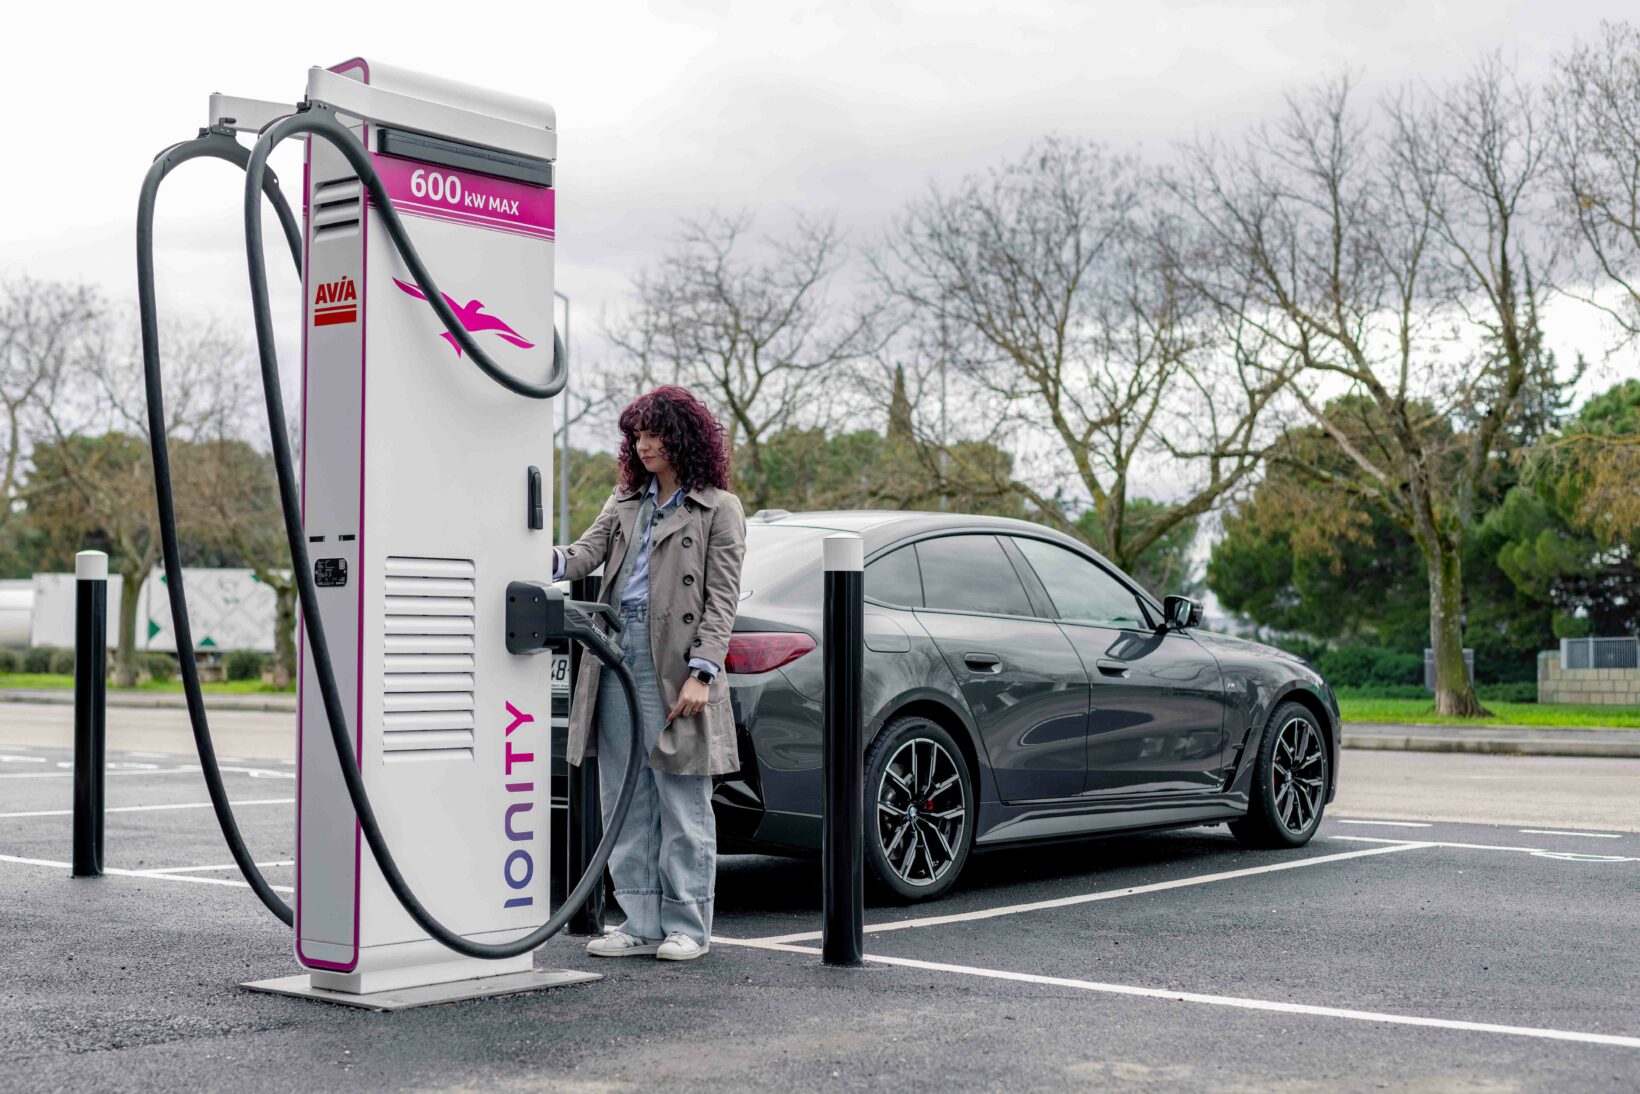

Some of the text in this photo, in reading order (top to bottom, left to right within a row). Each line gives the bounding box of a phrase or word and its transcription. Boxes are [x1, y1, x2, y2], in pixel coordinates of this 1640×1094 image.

[410, 169, 519, 216] 600 kW MAX
[503, 699, 535, 909] IONITY
